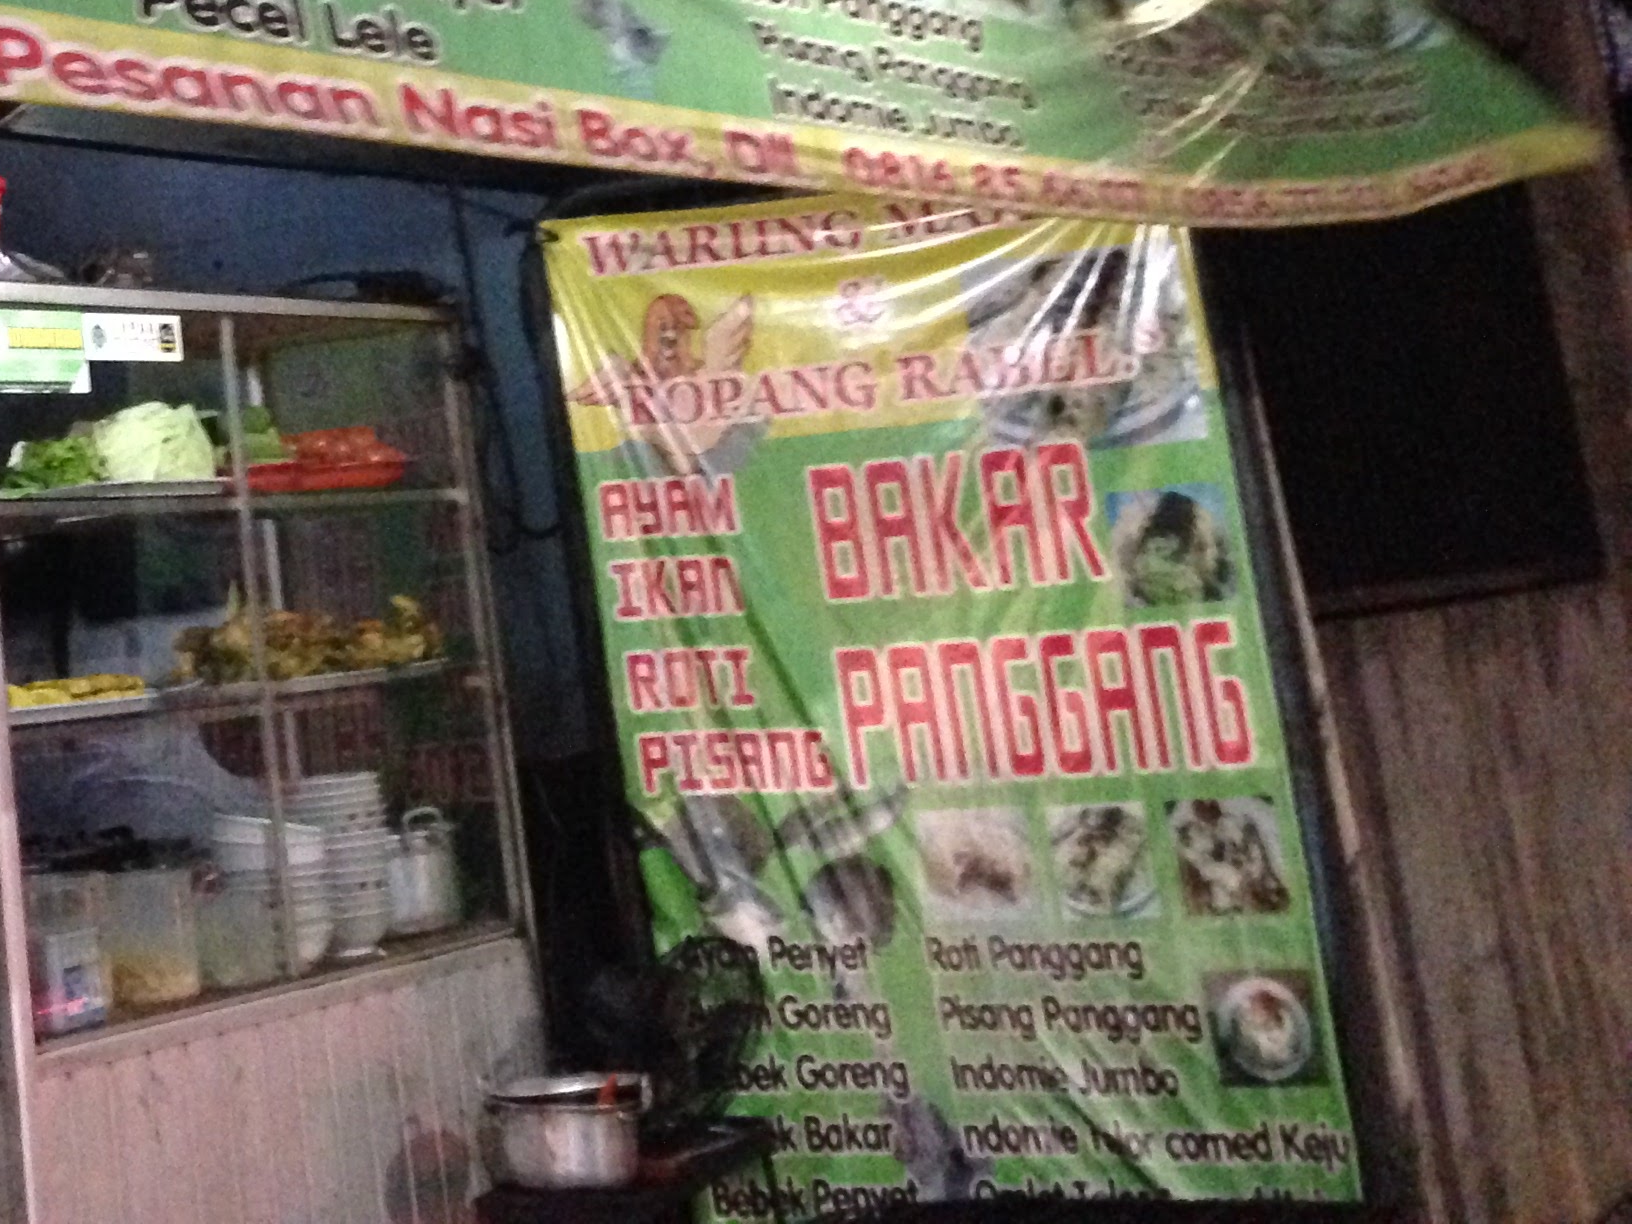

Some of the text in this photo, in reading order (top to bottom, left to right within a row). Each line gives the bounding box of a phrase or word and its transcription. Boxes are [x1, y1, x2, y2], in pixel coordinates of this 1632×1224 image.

[325, 3, 437, 62] Lele
[401, 83, 558, 148] Nasi
[582, 206, 862, 274] WARUNG
[624, 360, 878, 426] ROPANG
[600, 478, 739, 538] AYAM
[808, 443, 1107, 600] BAKAR
[611, 558, 744, 618] IKAN
[627, 651, 755, 711] ROTI
[834, 620, 1251, 788] PANGGANG
[639, 731, 835, 793] PISANG
[768, 935, 867, 979] Penyet
[926, 935, 1145, 980] Roti Panggang
[777, 994, 893, 1040] Goreng
[940, 994, 1204, 1045] Pisang Panggang
[796, 1054, 911, 1099] Goreng
[804, 1113, 894, 1153] Bakar
